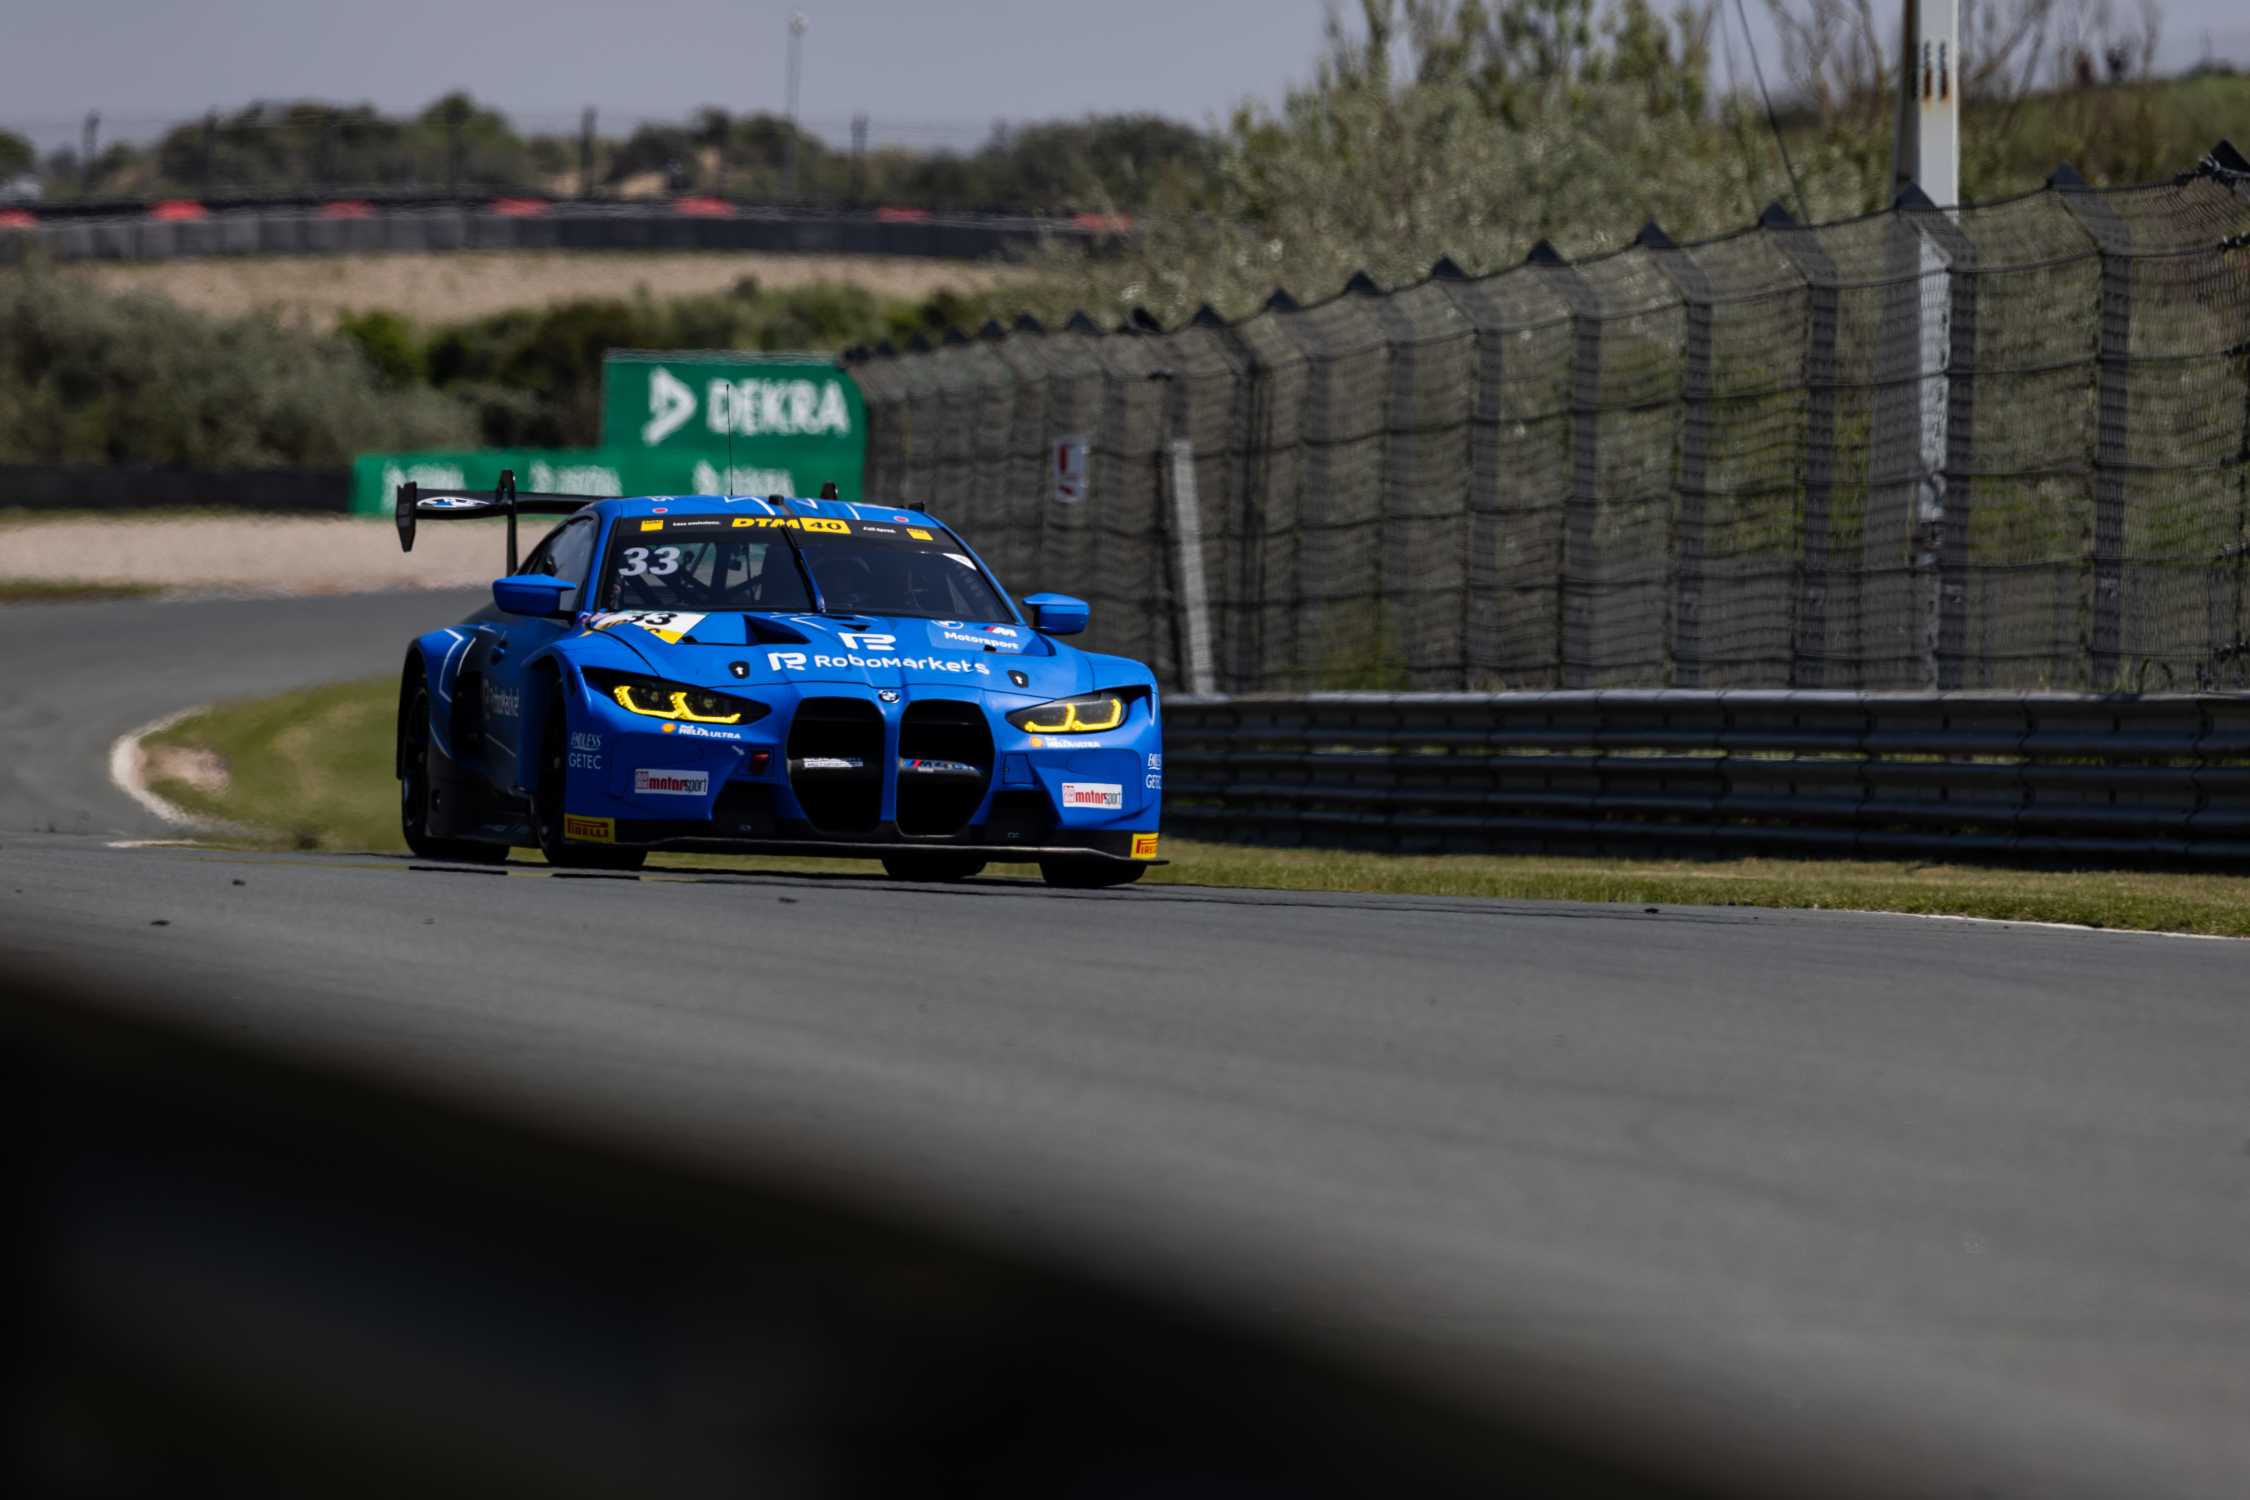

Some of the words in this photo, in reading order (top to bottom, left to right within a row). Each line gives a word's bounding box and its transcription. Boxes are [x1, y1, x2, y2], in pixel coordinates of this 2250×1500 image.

[706, 379, 850, 436] DEKRA
[732, 518, 800, 529] DTM
[808, 520, 842, 532] 40
[618, 546, 681, 577] 33
[943, 631, 1020, 650] Motorsport
[814, 654, 990, 676] RoboMarkets
[710, 730, 741, 739] ULTRA
[568, 753, 602, 769] GETEC
[648, 775, 707, 792] motorsport
